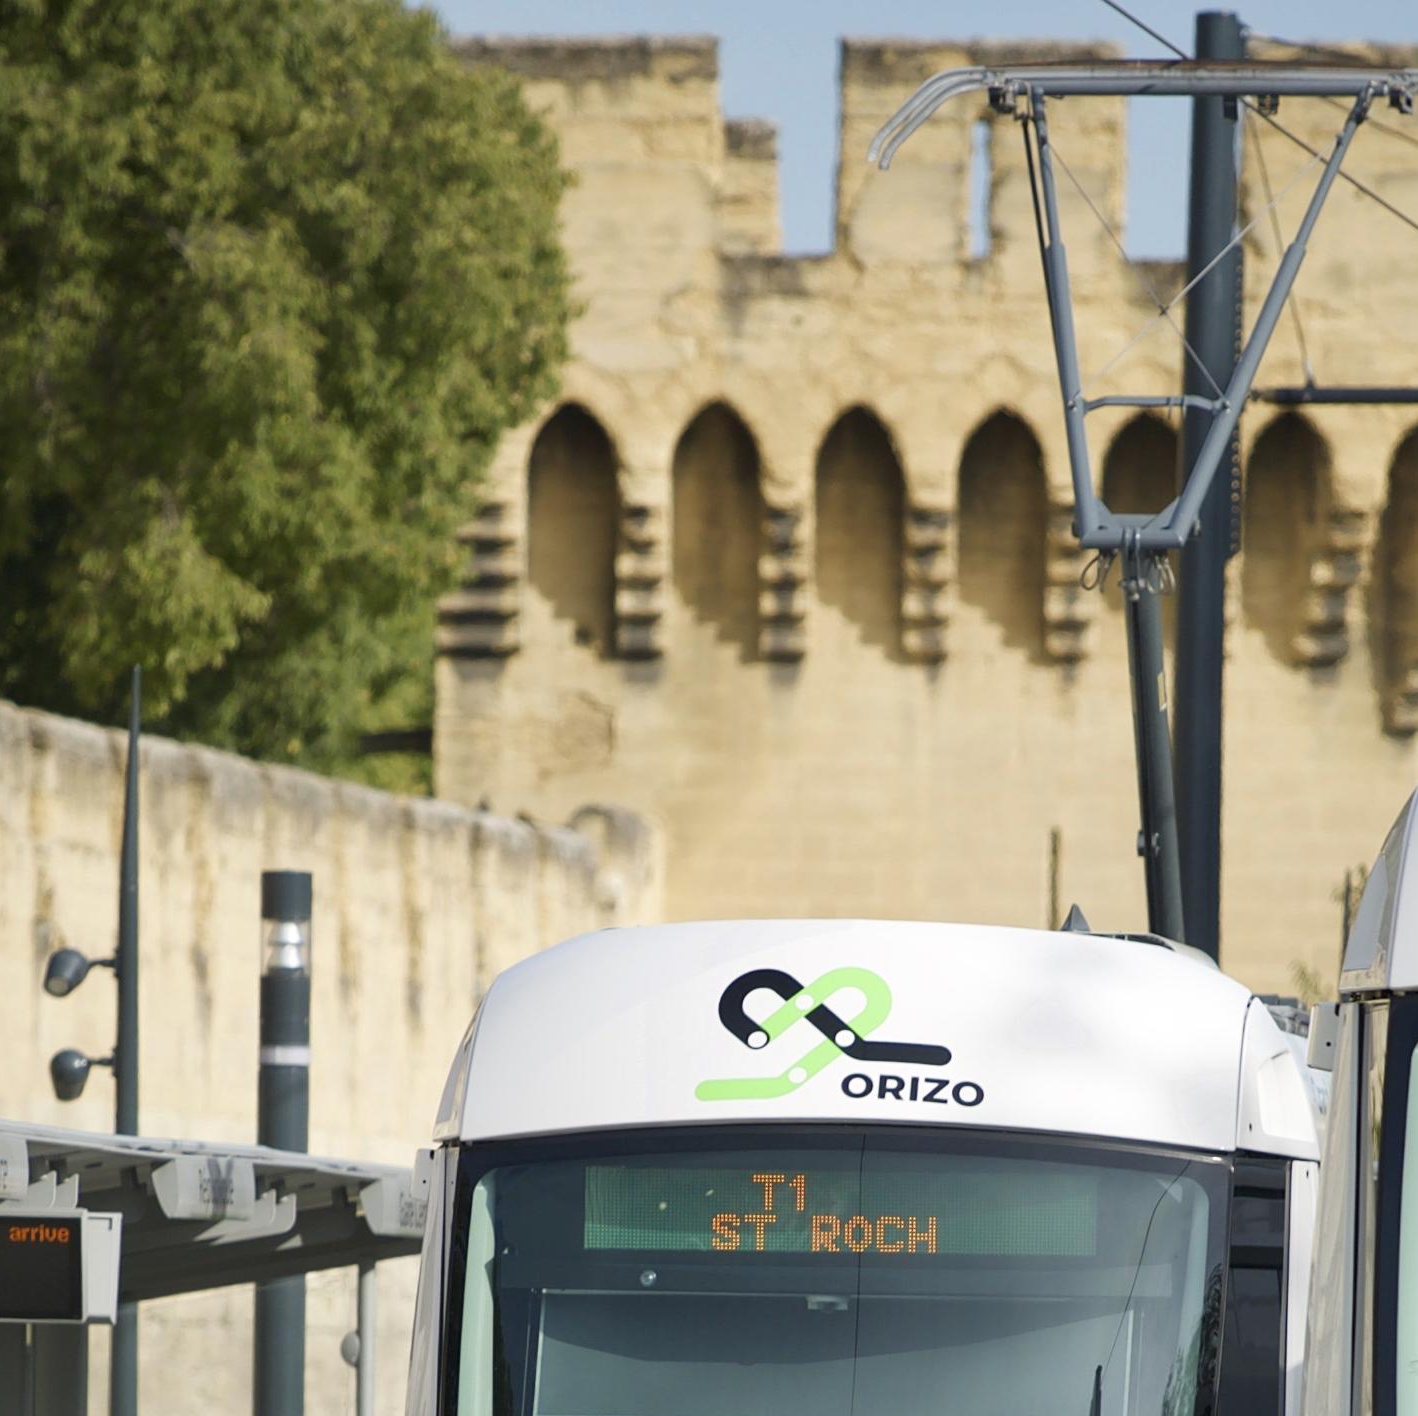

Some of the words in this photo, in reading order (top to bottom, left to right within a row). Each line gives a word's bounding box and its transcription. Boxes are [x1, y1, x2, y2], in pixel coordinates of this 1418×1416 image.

[840, 1072, 985, 1107] ORIZO
[752, 1173, 806, 1212] T1
[8, 1224, 70, 1243] arrive
[711, 1213, 777, 1251] ST
[811, 1215, 937, 1254] ROCH
